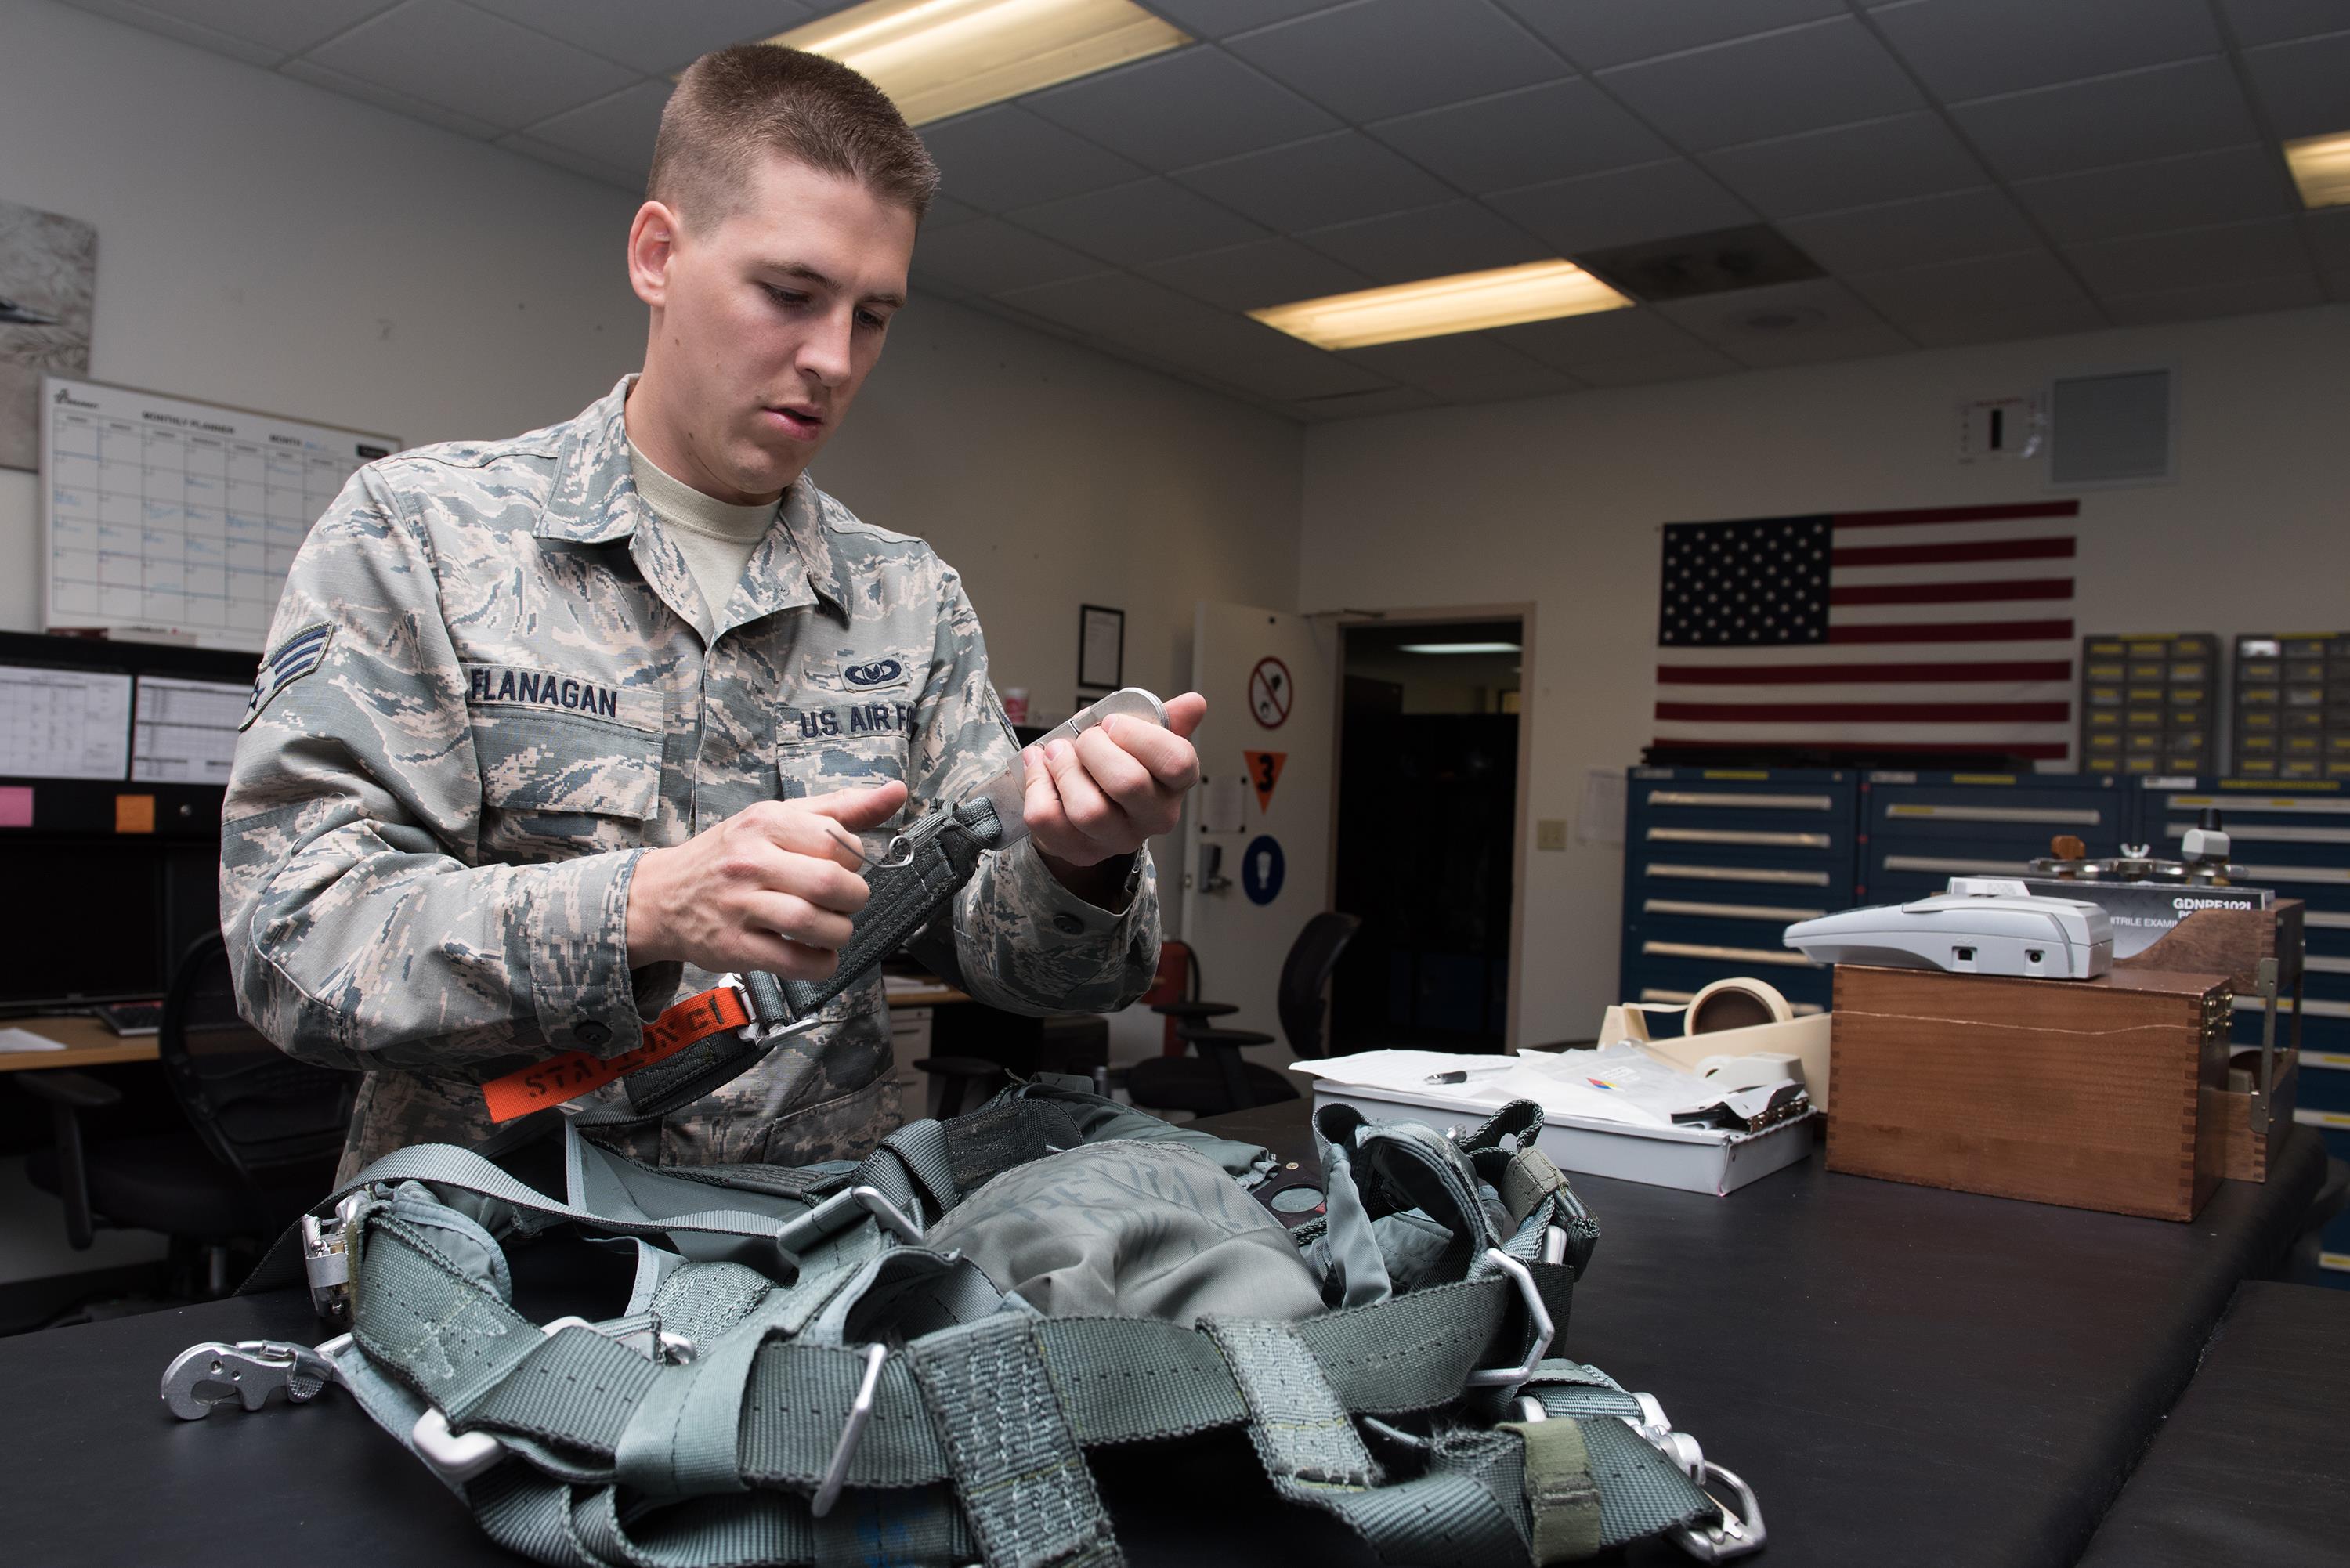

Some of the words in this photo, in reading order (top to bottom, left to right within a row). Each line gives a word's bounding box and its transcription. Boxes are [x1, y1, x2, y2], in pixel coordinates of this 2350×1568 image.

[471, 667, 617, 718] FLANAGAN
[851, 706, 891, 732] AIR
[1257, 753, 1275, 793] 3
